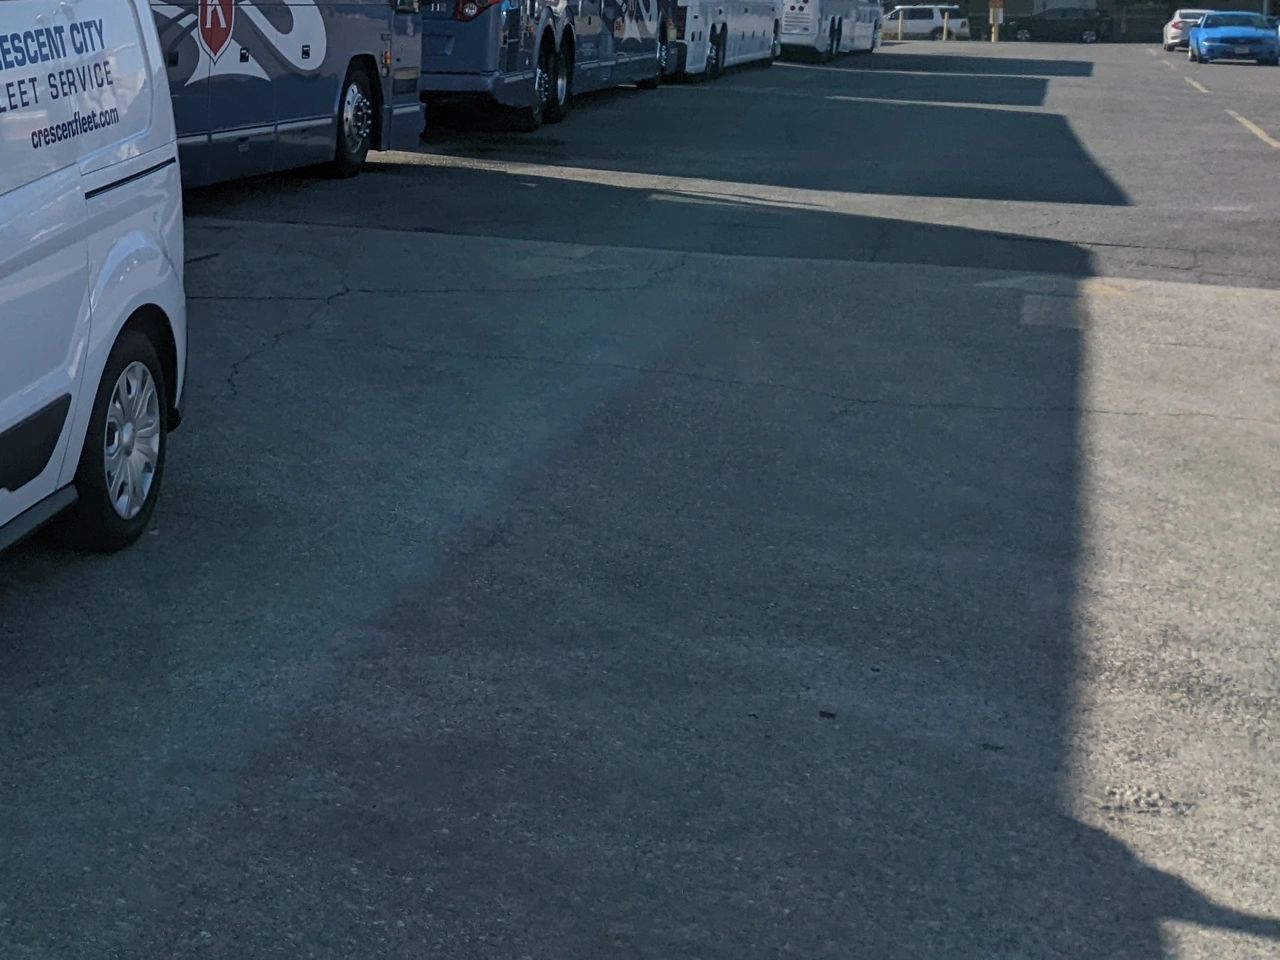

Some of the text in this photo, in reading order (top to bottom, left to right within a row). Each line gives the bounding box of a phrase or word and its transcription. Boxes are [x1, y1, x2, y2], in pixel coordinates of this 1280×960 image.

[69, 18, 106, 56] CITY
[47, 60, 114, 100] SERVICE
[31, 107, 120, 149] crescentfleet.com
